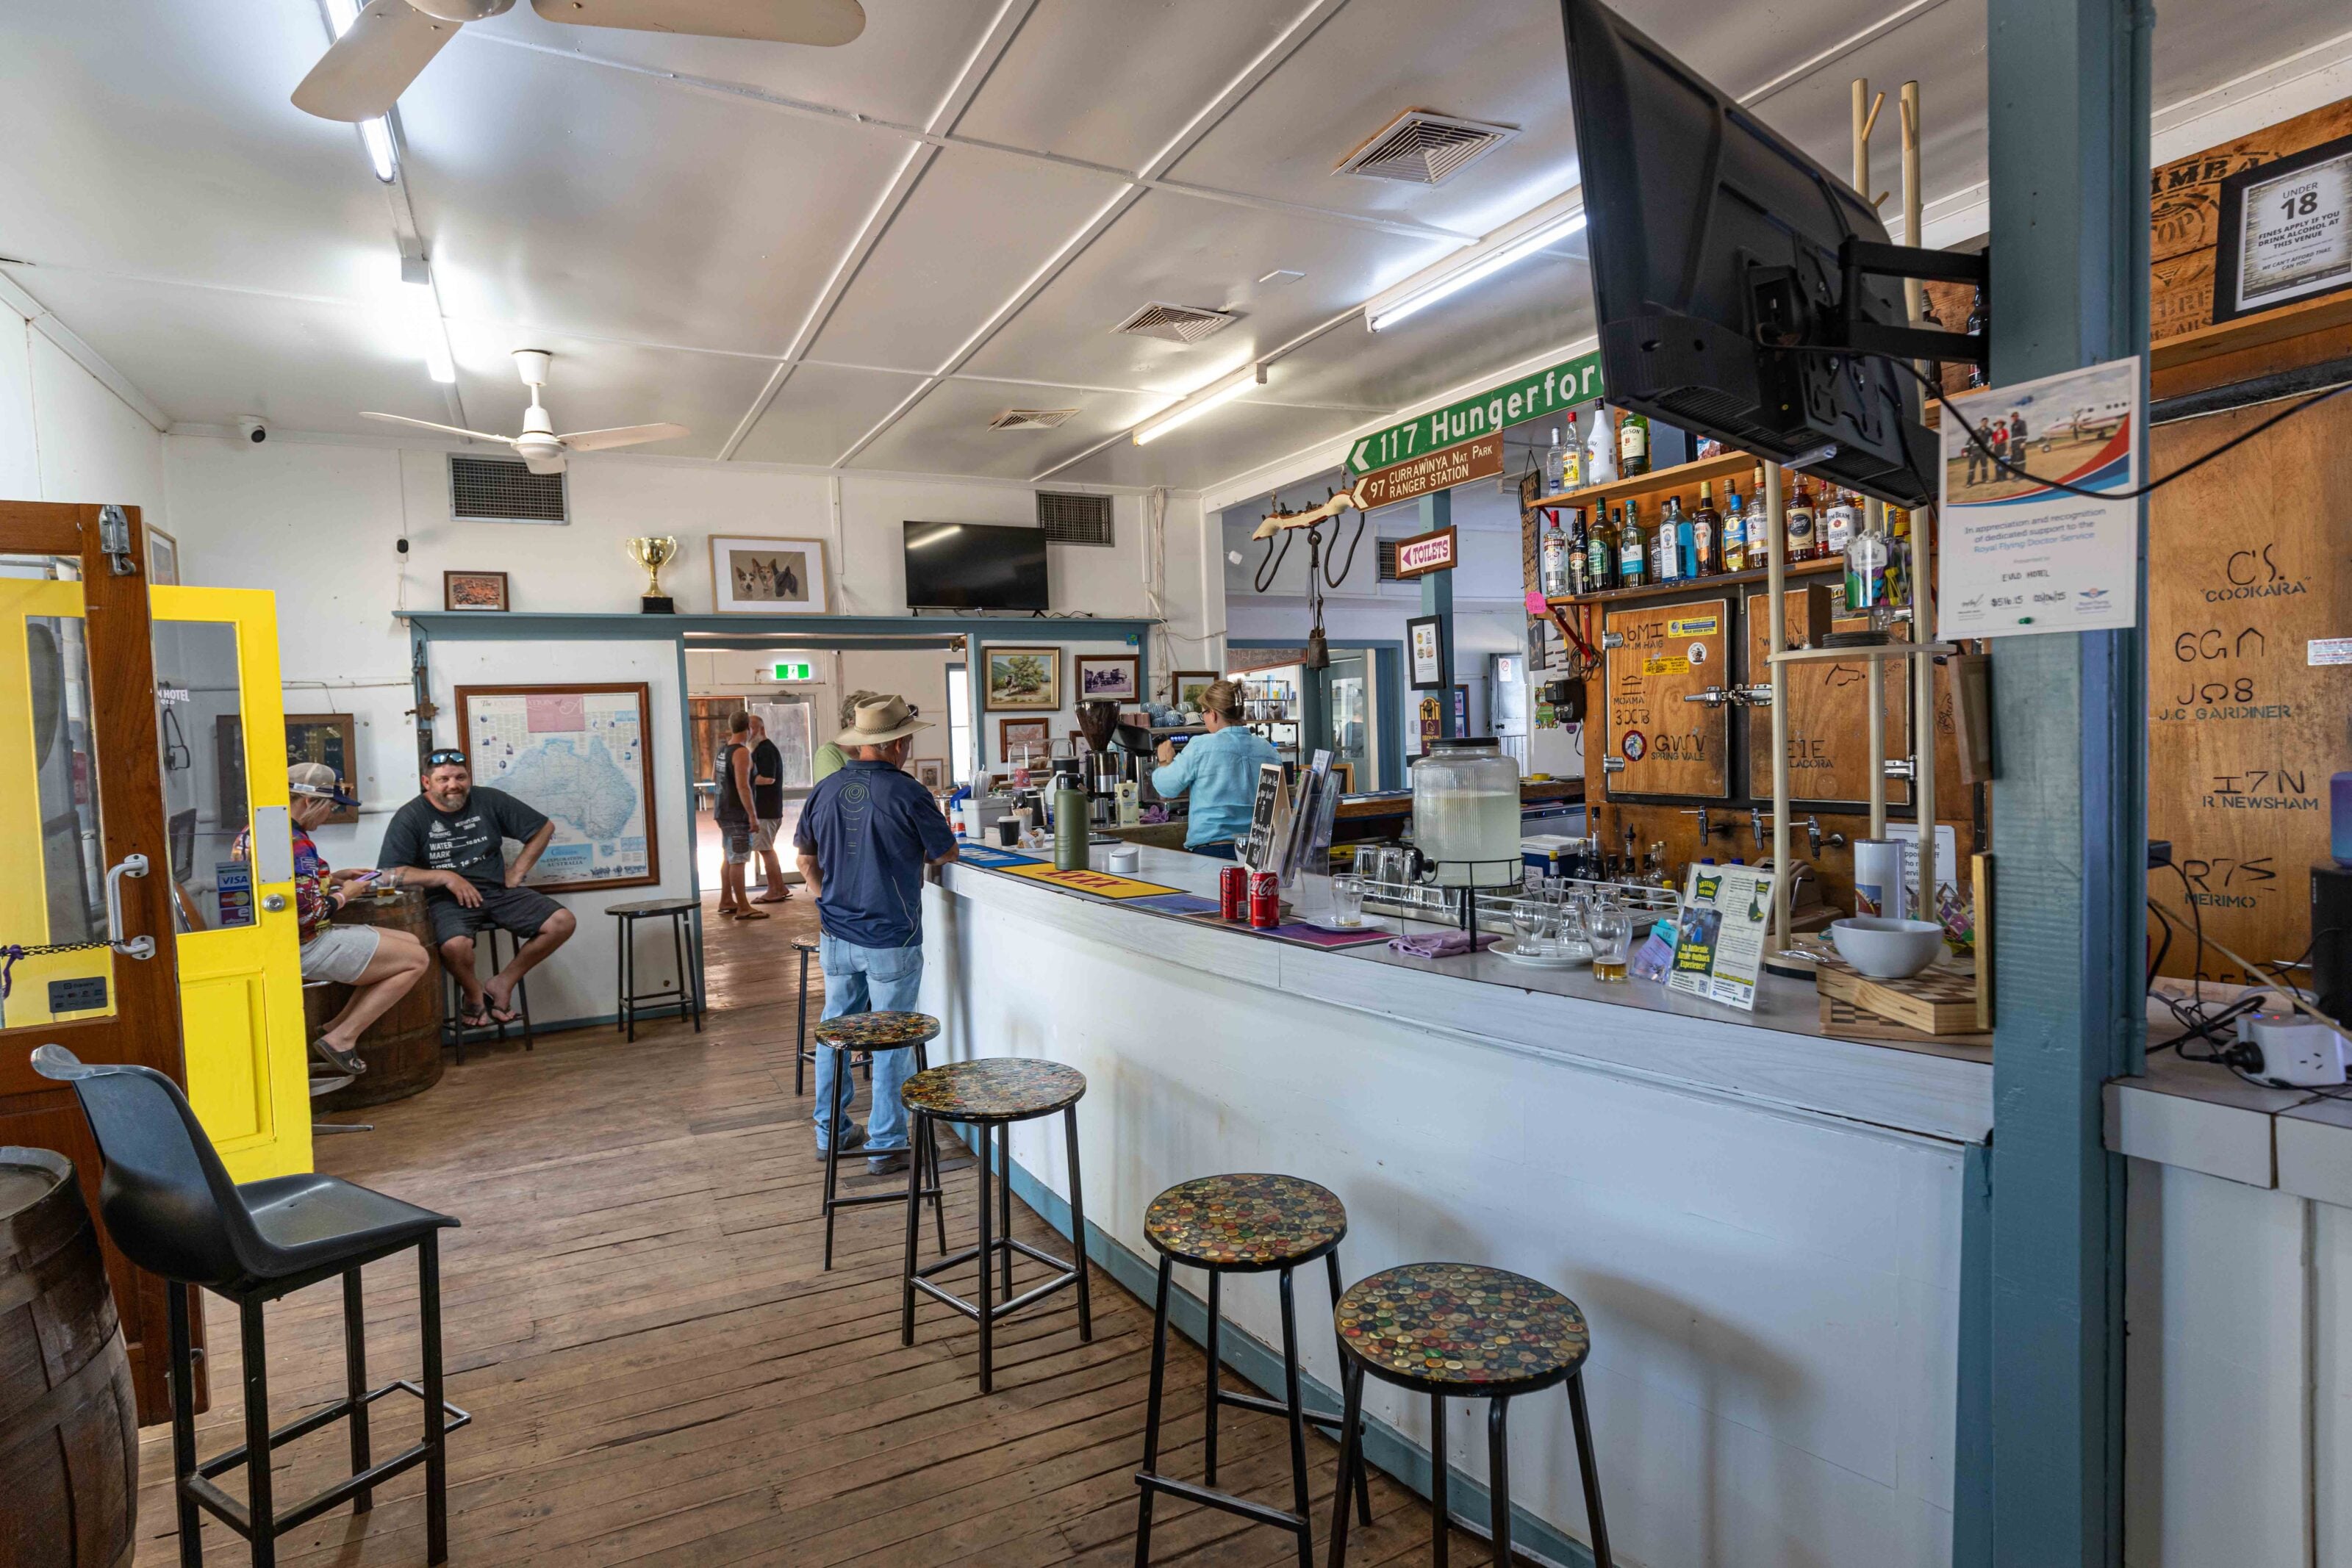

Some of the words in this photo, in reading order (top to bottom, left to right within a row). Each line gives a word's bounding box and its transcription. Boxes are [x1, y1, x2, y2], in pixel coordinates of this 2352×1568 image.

[2283, 182, 2318, 199] UNDER
[2280, 192, 2317, 220] 18
[2258, 234, 2285, 247] DRINK
[2287, 223, 2327, 239] ALCOHOL
[2328, 217, 2340, 226] AT
[2259, 228, 2282, 240] FINES
[2284, 220, 2310, 232] APPLY
[2312, 216, 2320, 225] IF
[2322, 211, 2340, 222] YOU
[2273, 240, 2292, 250] THIS
[2294, 231, 2323, 242] VENUE
[2273, 259, 2290, 268] CAN'T
[2291, 251, 2315, 263] AFFORD
[1380, 422, 1419, 463] 117
[1431, 363, 1605, 445] Hungerfor
[1370, 478, 1386, 500] 97
[1389, 458, 1449, 486] CURRAWINYA
[1389, 477, 1427, 500] RANGER
[1430, 464, 1469, 488] STATION
[1835, 511, 1850, 519] BEAM
[1976, 519, 2031, 534] appreciation
[2032, 517, 2049, 525] and
[2051, 508, 2107, 522] recognition
[1974, 535, 1984, 544] of
[1985, 530, 2028, 542] dedicated
[2029, 524, 2065, 536] support
[2079, 520, 2094, 528] the
[1974, 542, 1998, 554] Royal
[1999, 539, 2026, 551] Flying
[2028, 537, 2058, 547] Doctor
[2060, 532, 2095, 542] Service
[2026, 569, 2051, 578] HOTEL
[1643, 640, 1664, 650] HAIG
[163, 689, 190, 702] HOTEL
[1613, 696, 1645, 705] MOAMA
[2195, 705, 2292, 721] GARDINER
[1651, 752, 1679, 760] SPRING
[1682, 752, 1705, 761] VALE
[2222, 796, 2319, 810] NEWSHAM
[429, 842, 453, 851] WATER
[429, 851, 451, 860] MARK
[223, 875, 248, 885] VISA
[1680, 960, 1706, 971] Experience!
